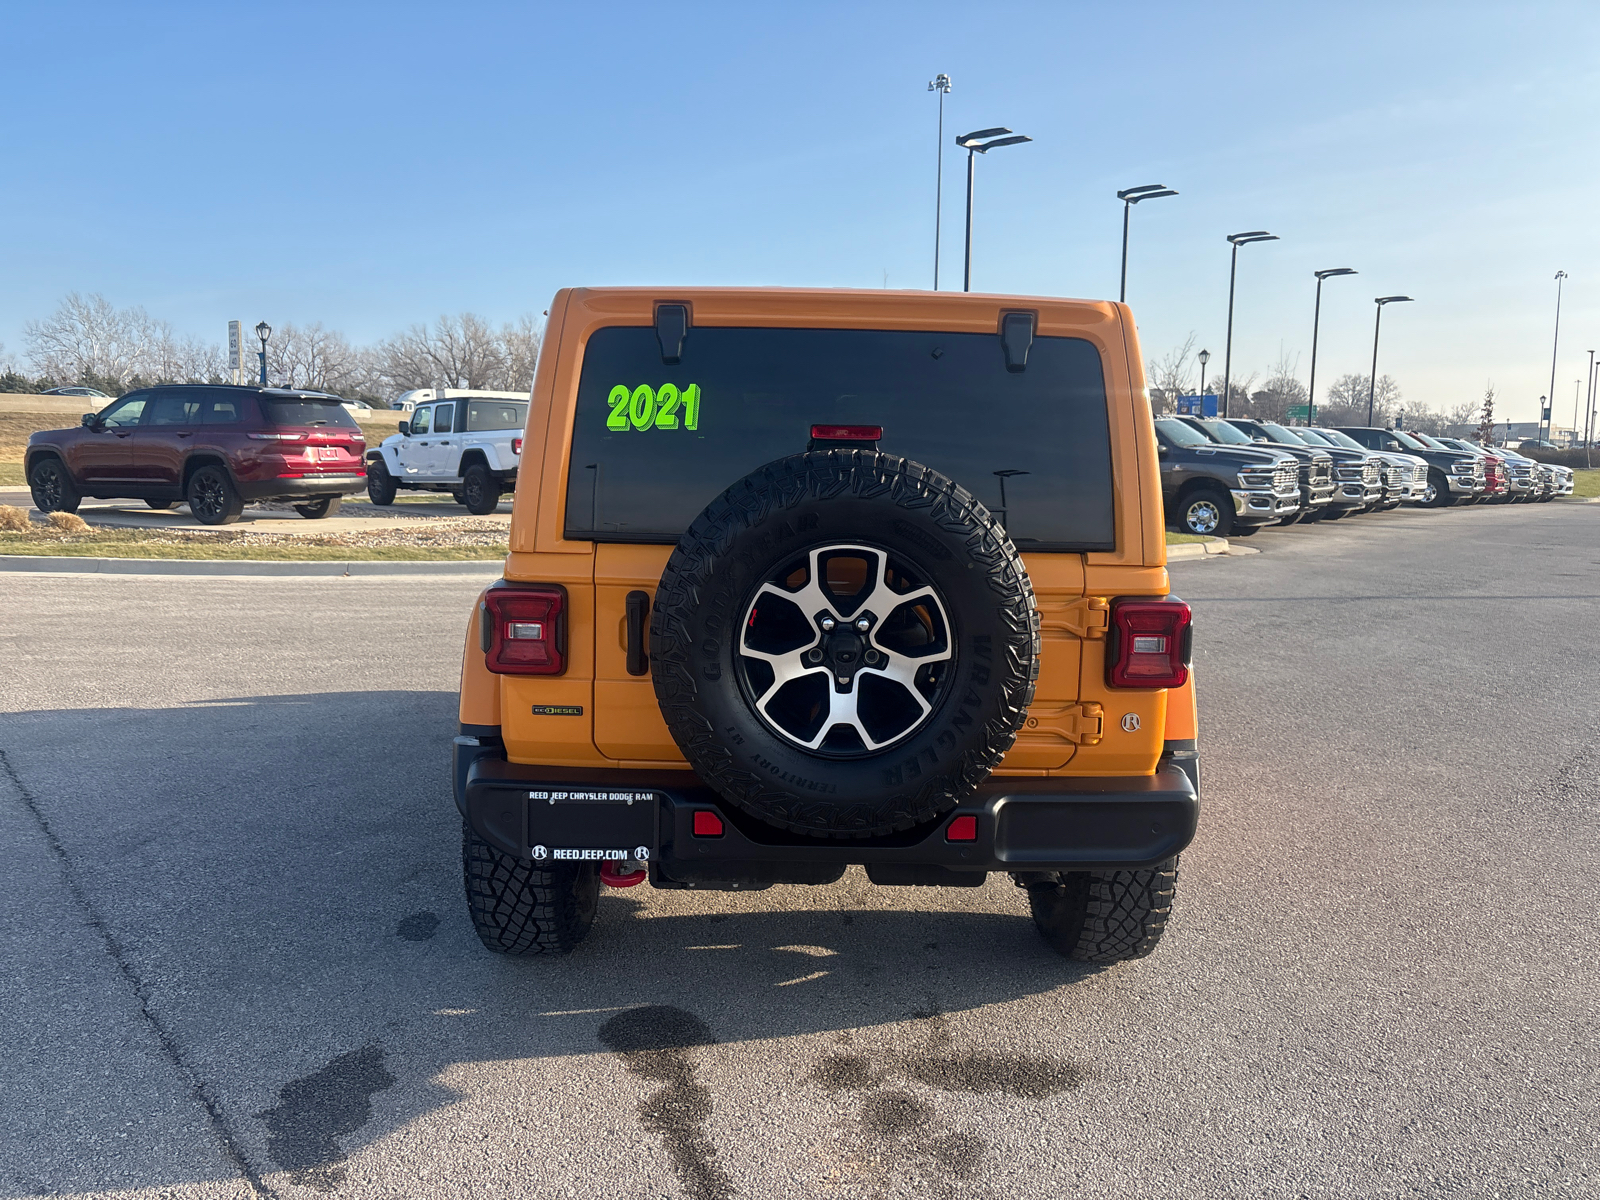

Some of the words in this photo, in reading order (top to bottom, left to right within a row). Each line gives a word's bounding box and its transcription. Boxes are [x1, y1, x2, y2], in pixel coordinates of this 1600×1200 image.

[606, 382, 702, 432] 2021
[880, 634, 993, 789] WRANGLER
[749, 753, 838, 794] TERRITORY
[529, 791, 548, 799] REED
[550, 791, 568, 800] JEEP
[569, 792, 608, 800] CHRYSLER
[609, 792, 634, 801] DODGE
[635, 793, 653, 801] RAM
[553, 849, 628, 860] REEDJEEP.COM
